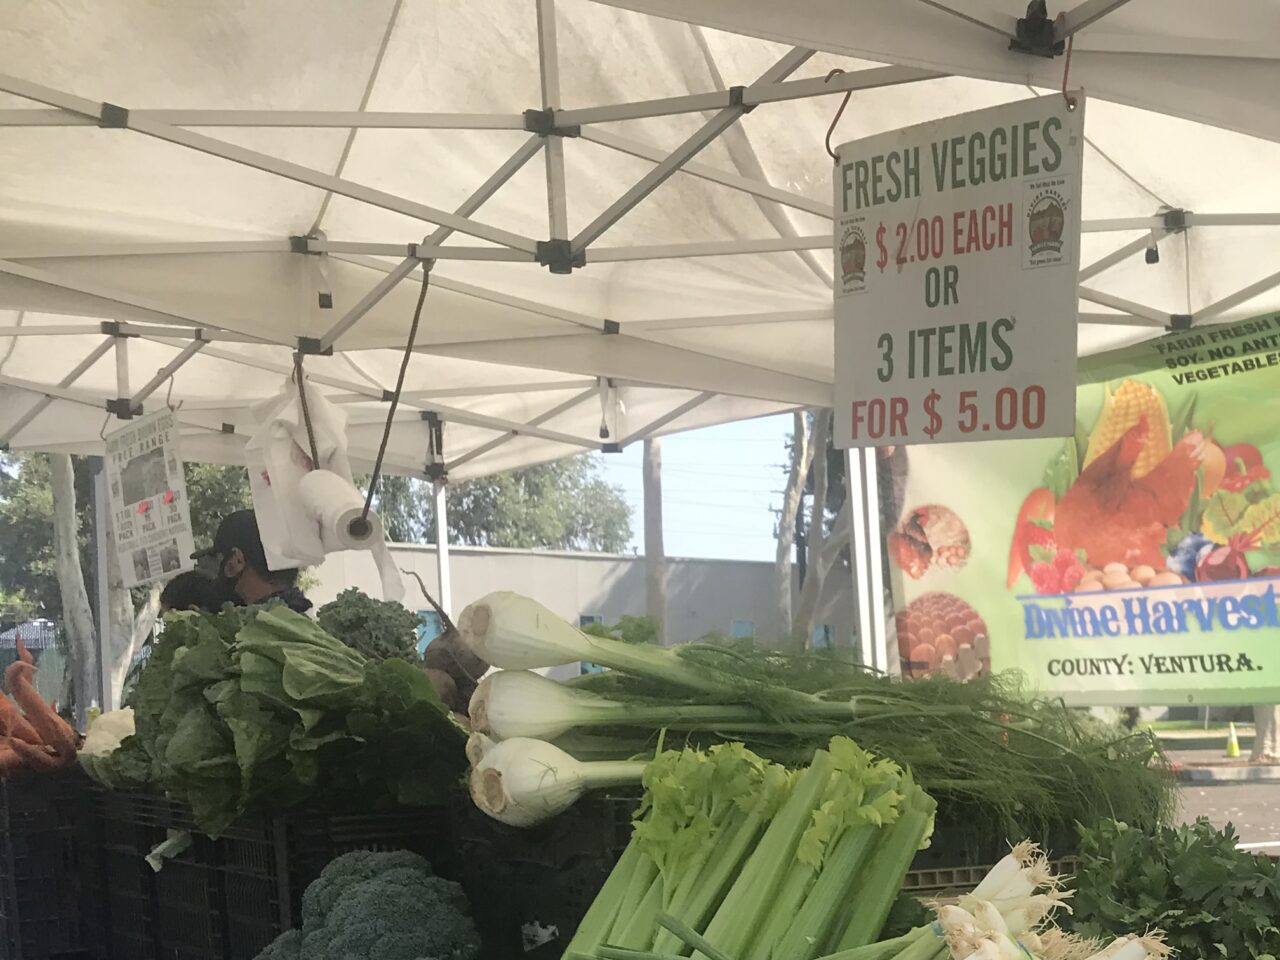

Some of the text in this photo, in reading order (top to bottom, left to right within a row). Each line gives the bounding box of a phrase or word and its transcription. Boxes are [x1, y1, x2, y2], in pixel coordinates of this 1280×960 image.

[842, 116, 1062, 212] FRESH VEGGIES
[953, 203, 1013, 255] EACH
[925, 264, 959, 308] OR
[877, 318, 1014, 383] 3 ITEMS
[1208, 319, 1272, 344] FRESH
[1208, 345, 1236, 361] NO
[851, 396, 909, 440] FOR
[1023, 598, 1121, 639] Divine
[1048, 653, 1263, 676] COUNTY: VENTURA.
